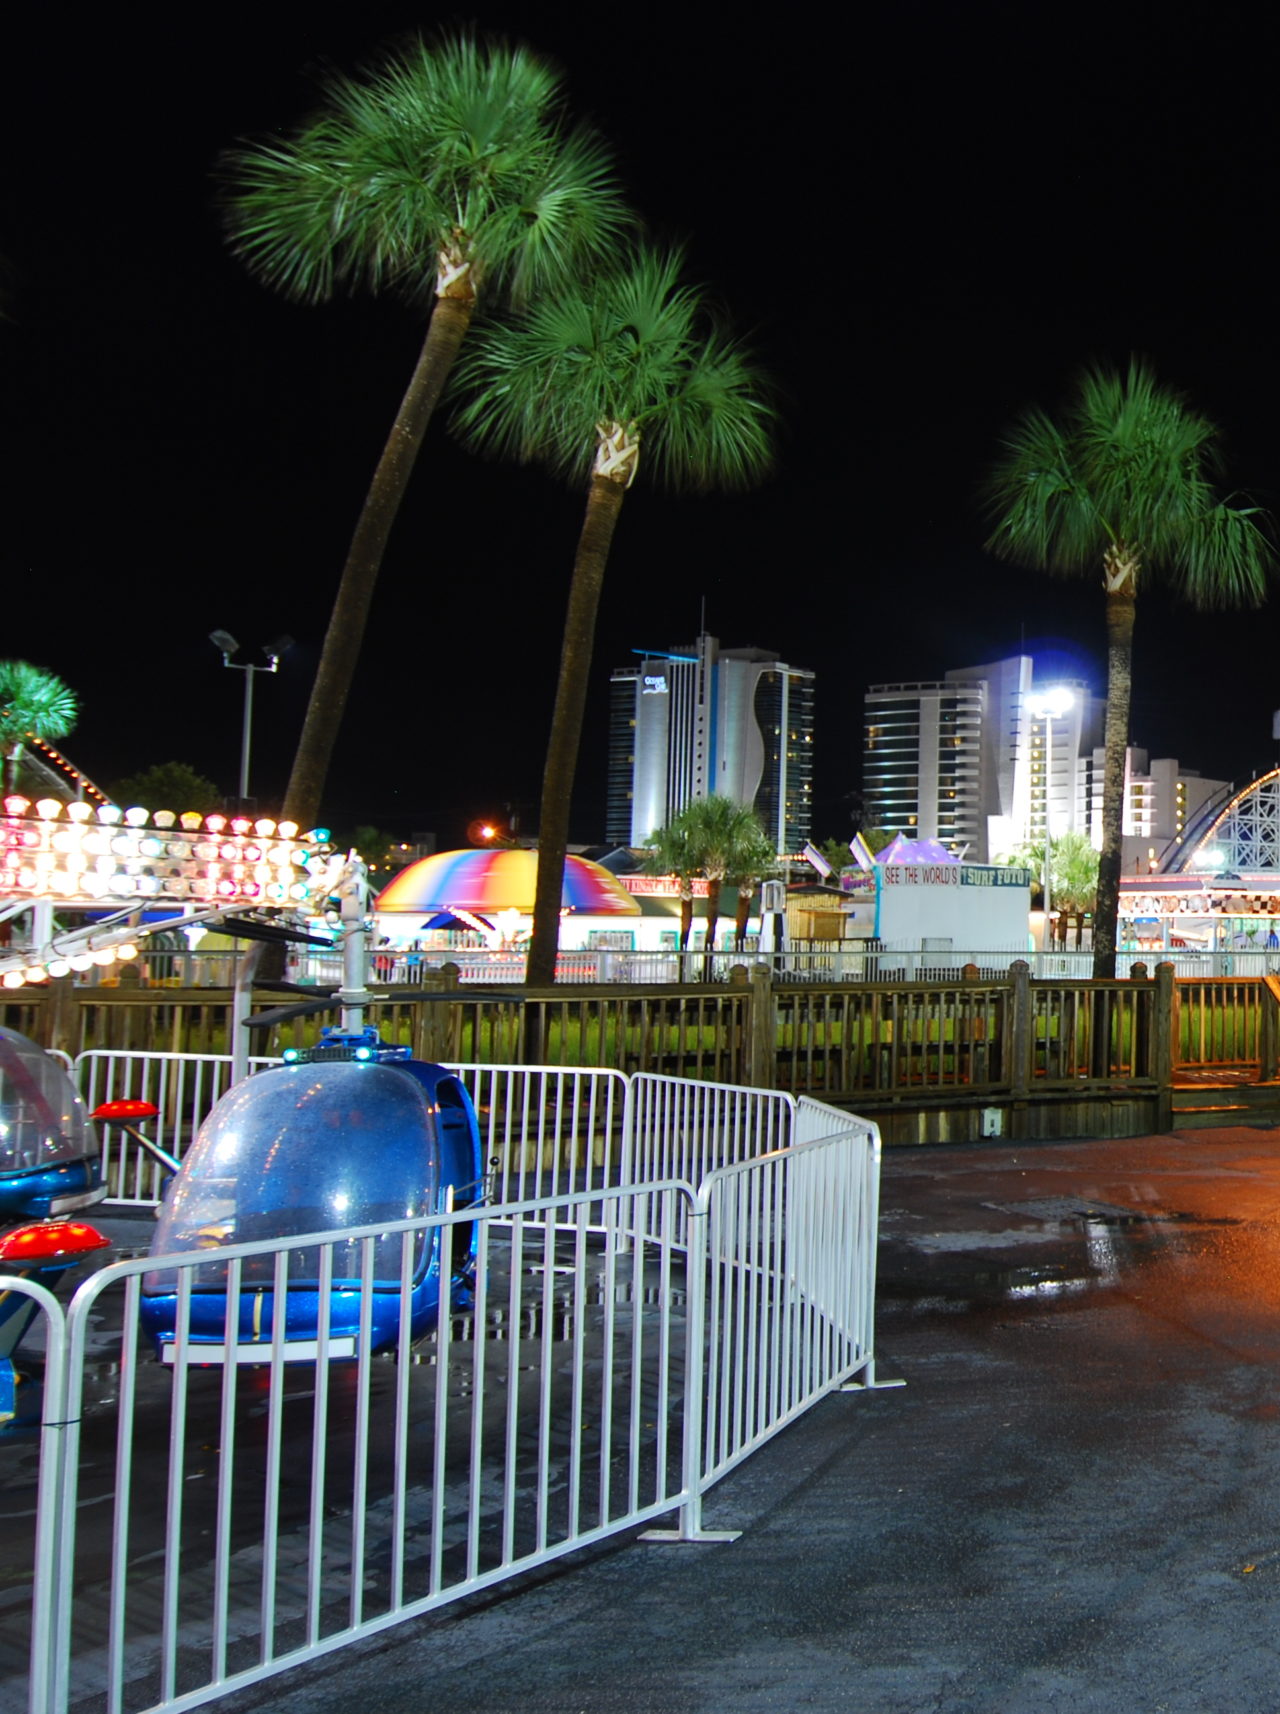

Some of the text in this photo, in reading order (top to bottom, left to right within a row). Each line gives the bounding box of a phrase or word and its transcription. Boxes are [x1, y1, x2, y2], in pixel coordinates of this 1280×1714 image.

[885, 866, 900, 885] SEE
[904, 867, 918, 884] THE
[967, 868, 1025, 886] SURF FOTO
